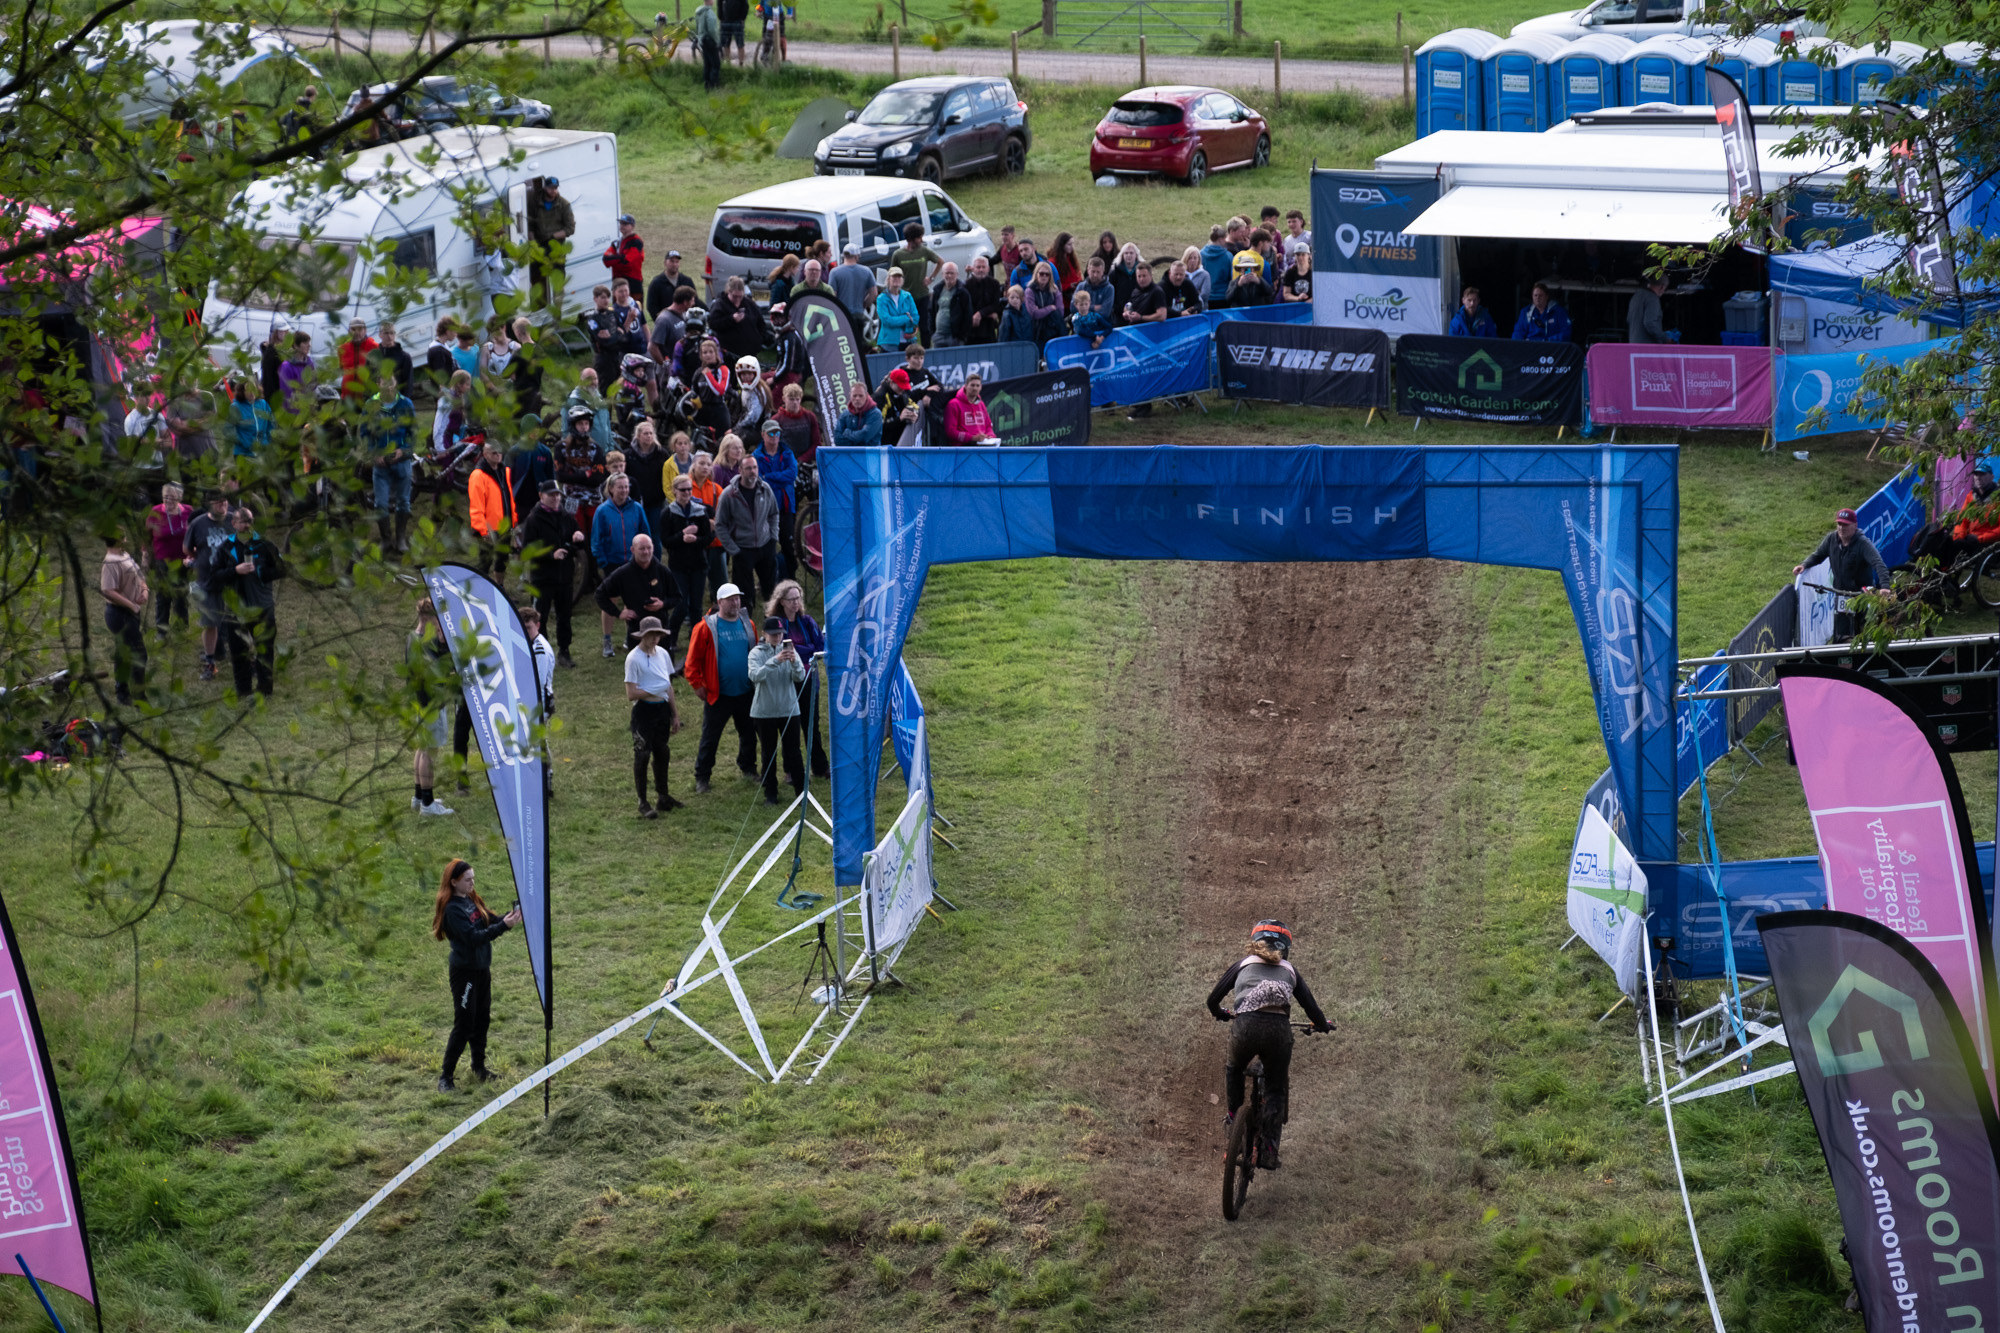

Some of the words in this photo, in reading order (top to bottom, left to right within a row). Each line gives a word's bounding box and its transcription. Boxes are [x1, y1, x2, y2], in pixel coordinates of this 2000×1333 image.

[1339, 187, 1386, 202] SDA
[732, 237, 760, 249] 07879
[762, 239, 782, 250] 640
[783, 240, 801, 251] 780
[1362, 230, 1418, 247] START
[1360, 246, 1417, 261] FITNESS
[1355, 293, 1390, 306] Green
[1345, 299, 1407, 321] Power
[1826, 312, 1863, 324] Green
[1813, 319, 1883, 340] Power
[1228, 344, 1267, 365] VEE
[1269, 346, 1331, 371] TIRE
[1331, 352, 1375, 373] CO.
[928, 362, 994, 384] START
[1521, 366, 1539, 374] 0800
[1640, 369, 1677, 382] Steam
[1686, 371, 1710, 380] Retail
[1640, 380, 1672, 392] Punk
[1687, 379, 1731, 389] Hospitality
[1036, 393, 1053, 405] 0800
[1053, 391, 1065, 402] 047
[1067, 387, 1082, 398] 2601
[1407, 386, 1457, 407] Scottish
[1459, 395, 1510, 410] Garden
[1513, 399, 1559, 411] Rooms
[1032, 425, 1072, 443] Rooms
[1197, 503, 1397, 526] FINISH
[836, 579, 896, 719] SDA
[1596, 587, 1650, 744] SDA
